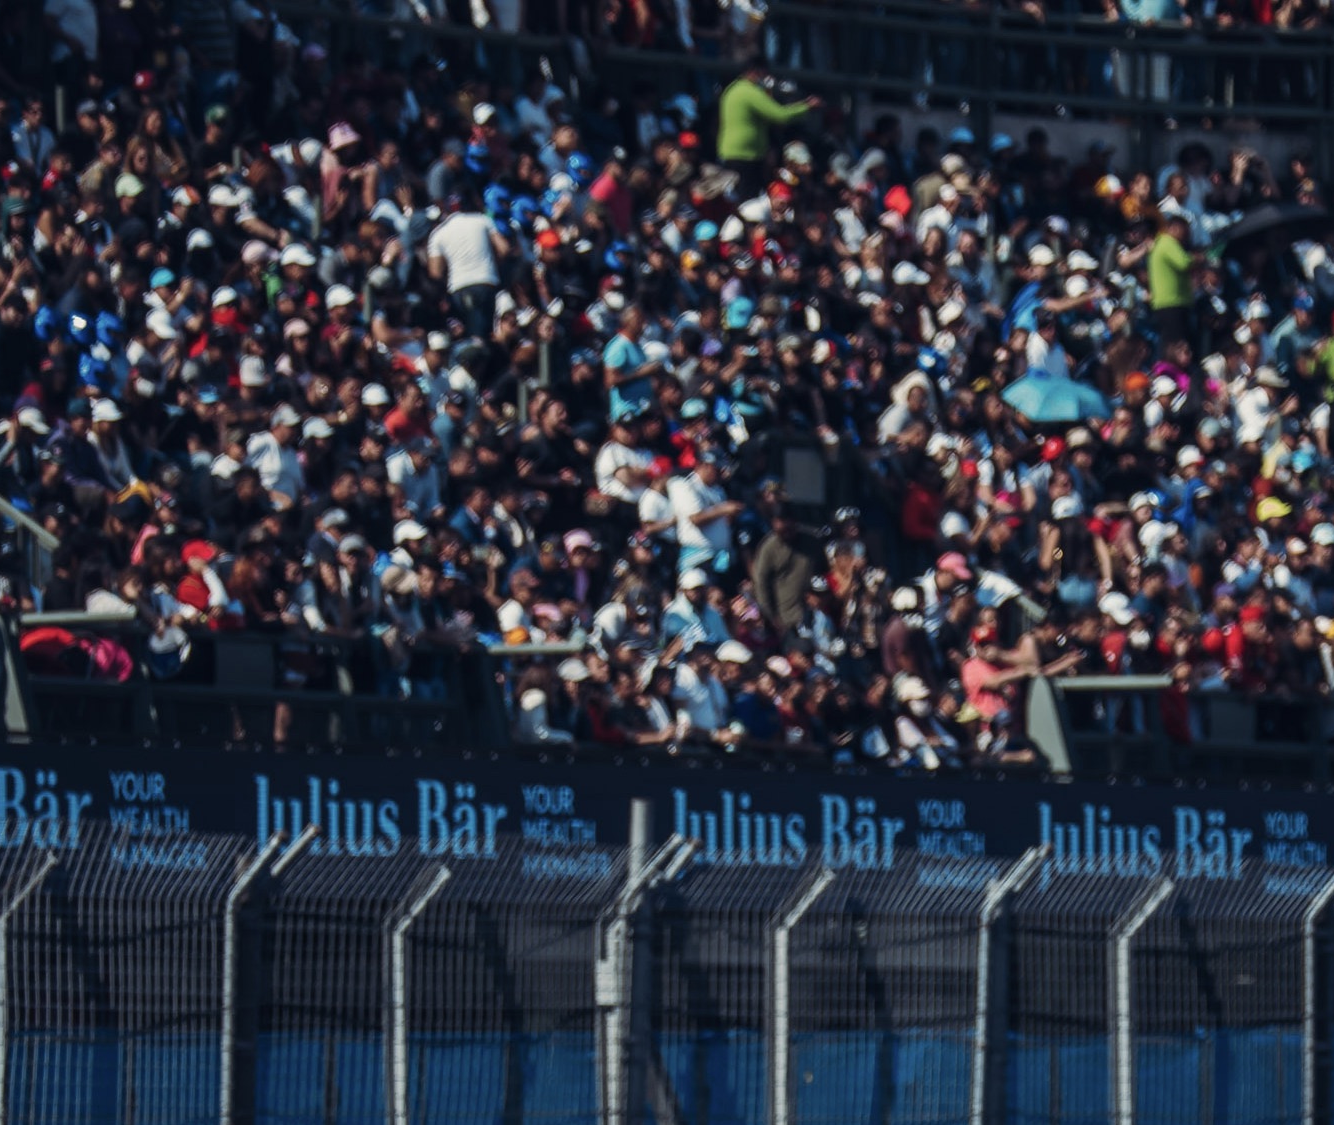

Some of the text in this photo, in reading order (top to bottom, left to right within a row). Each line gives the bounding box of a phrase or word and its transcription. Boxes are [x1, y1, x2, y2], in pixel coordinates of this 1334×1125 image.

[109, 769, 165, 803] YOUR
[521, 784, 575, 816] YOUR
[109, 805, 191, 835] WEALTH
[254, 773, 508, 860] Julius Bär
[916, 798, 965, 829] YOUR
[1264, 810, 1308, 839] YOUR
[672, 787, 905, 879] Julius Bär
[1037, 801, 1253, 892] Julius Bär
